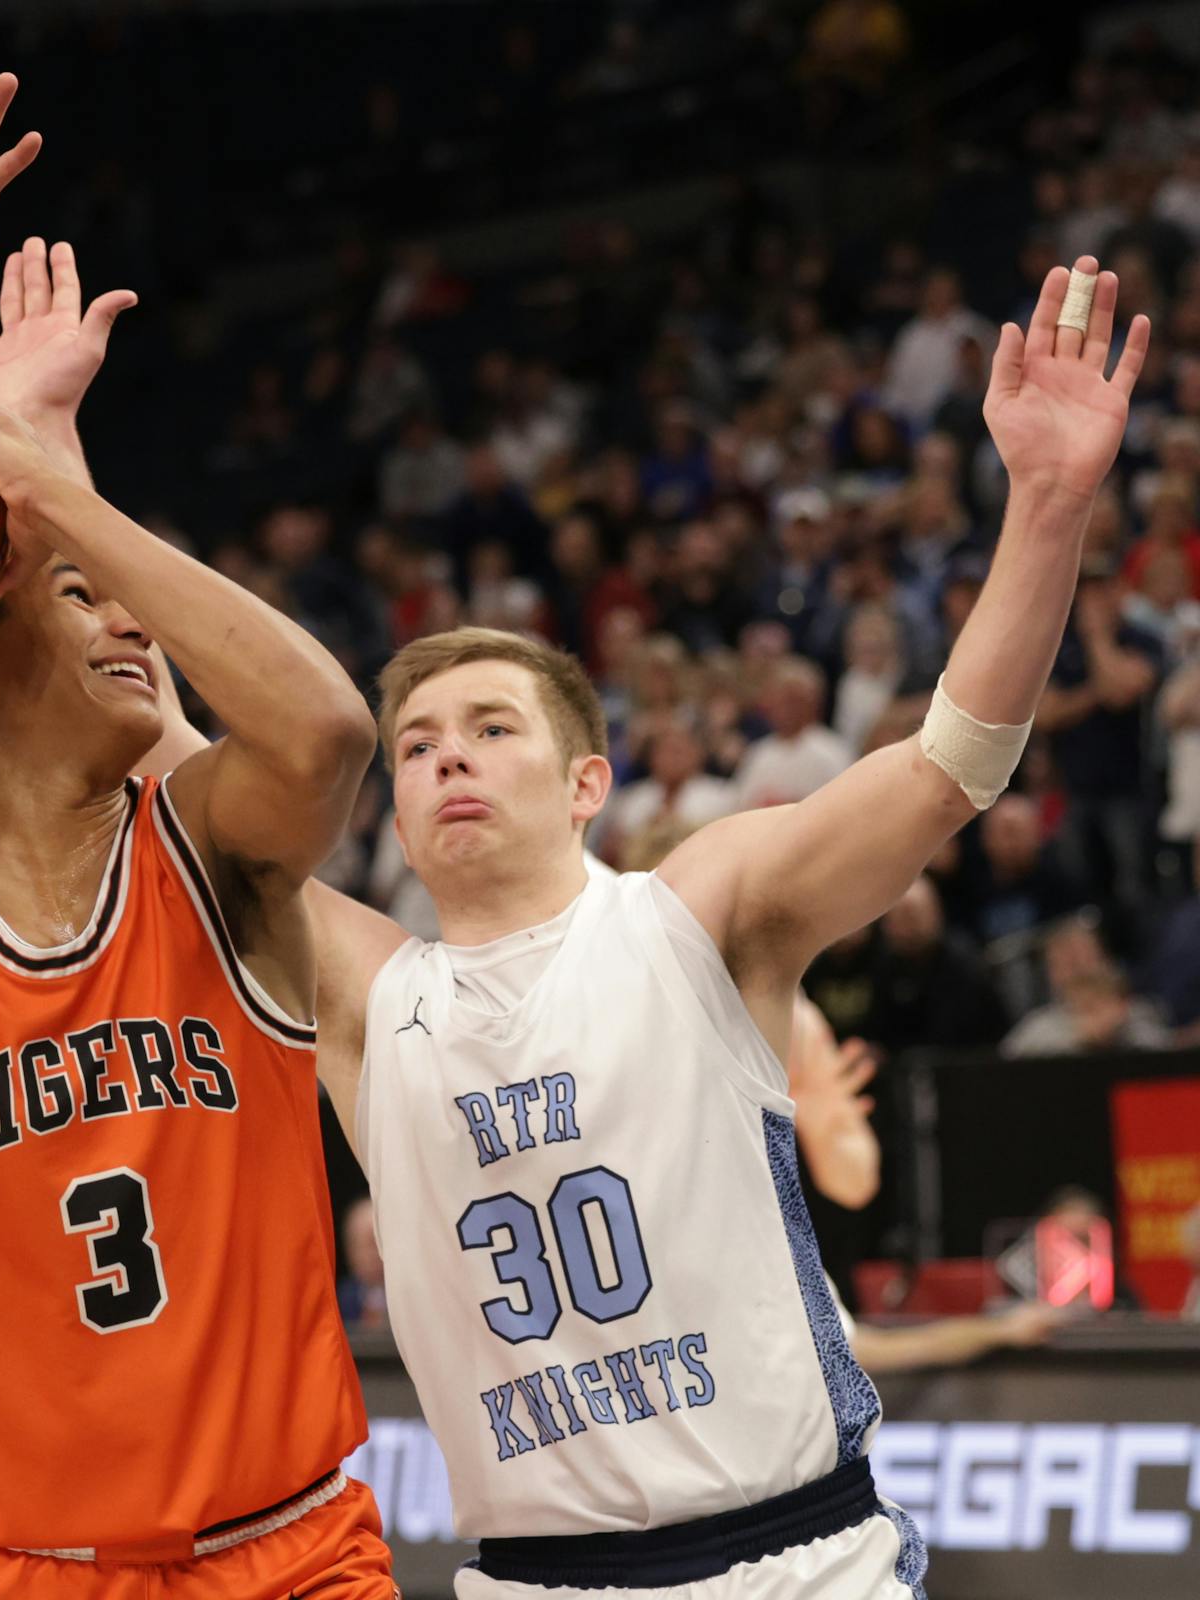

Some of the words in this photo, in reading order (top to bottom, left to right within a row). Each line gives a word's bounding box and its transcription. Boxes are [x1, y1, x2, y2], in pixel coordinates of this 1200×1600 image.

[454, 1072, 581, 1168] RTR
[60, 1166, 169, 1335] 3
[456, 1164, 653, 1345] 30
[480, 1332, 716, 1462] KNIGHTS
[867, 1421, 1200, 1553] EGAC
